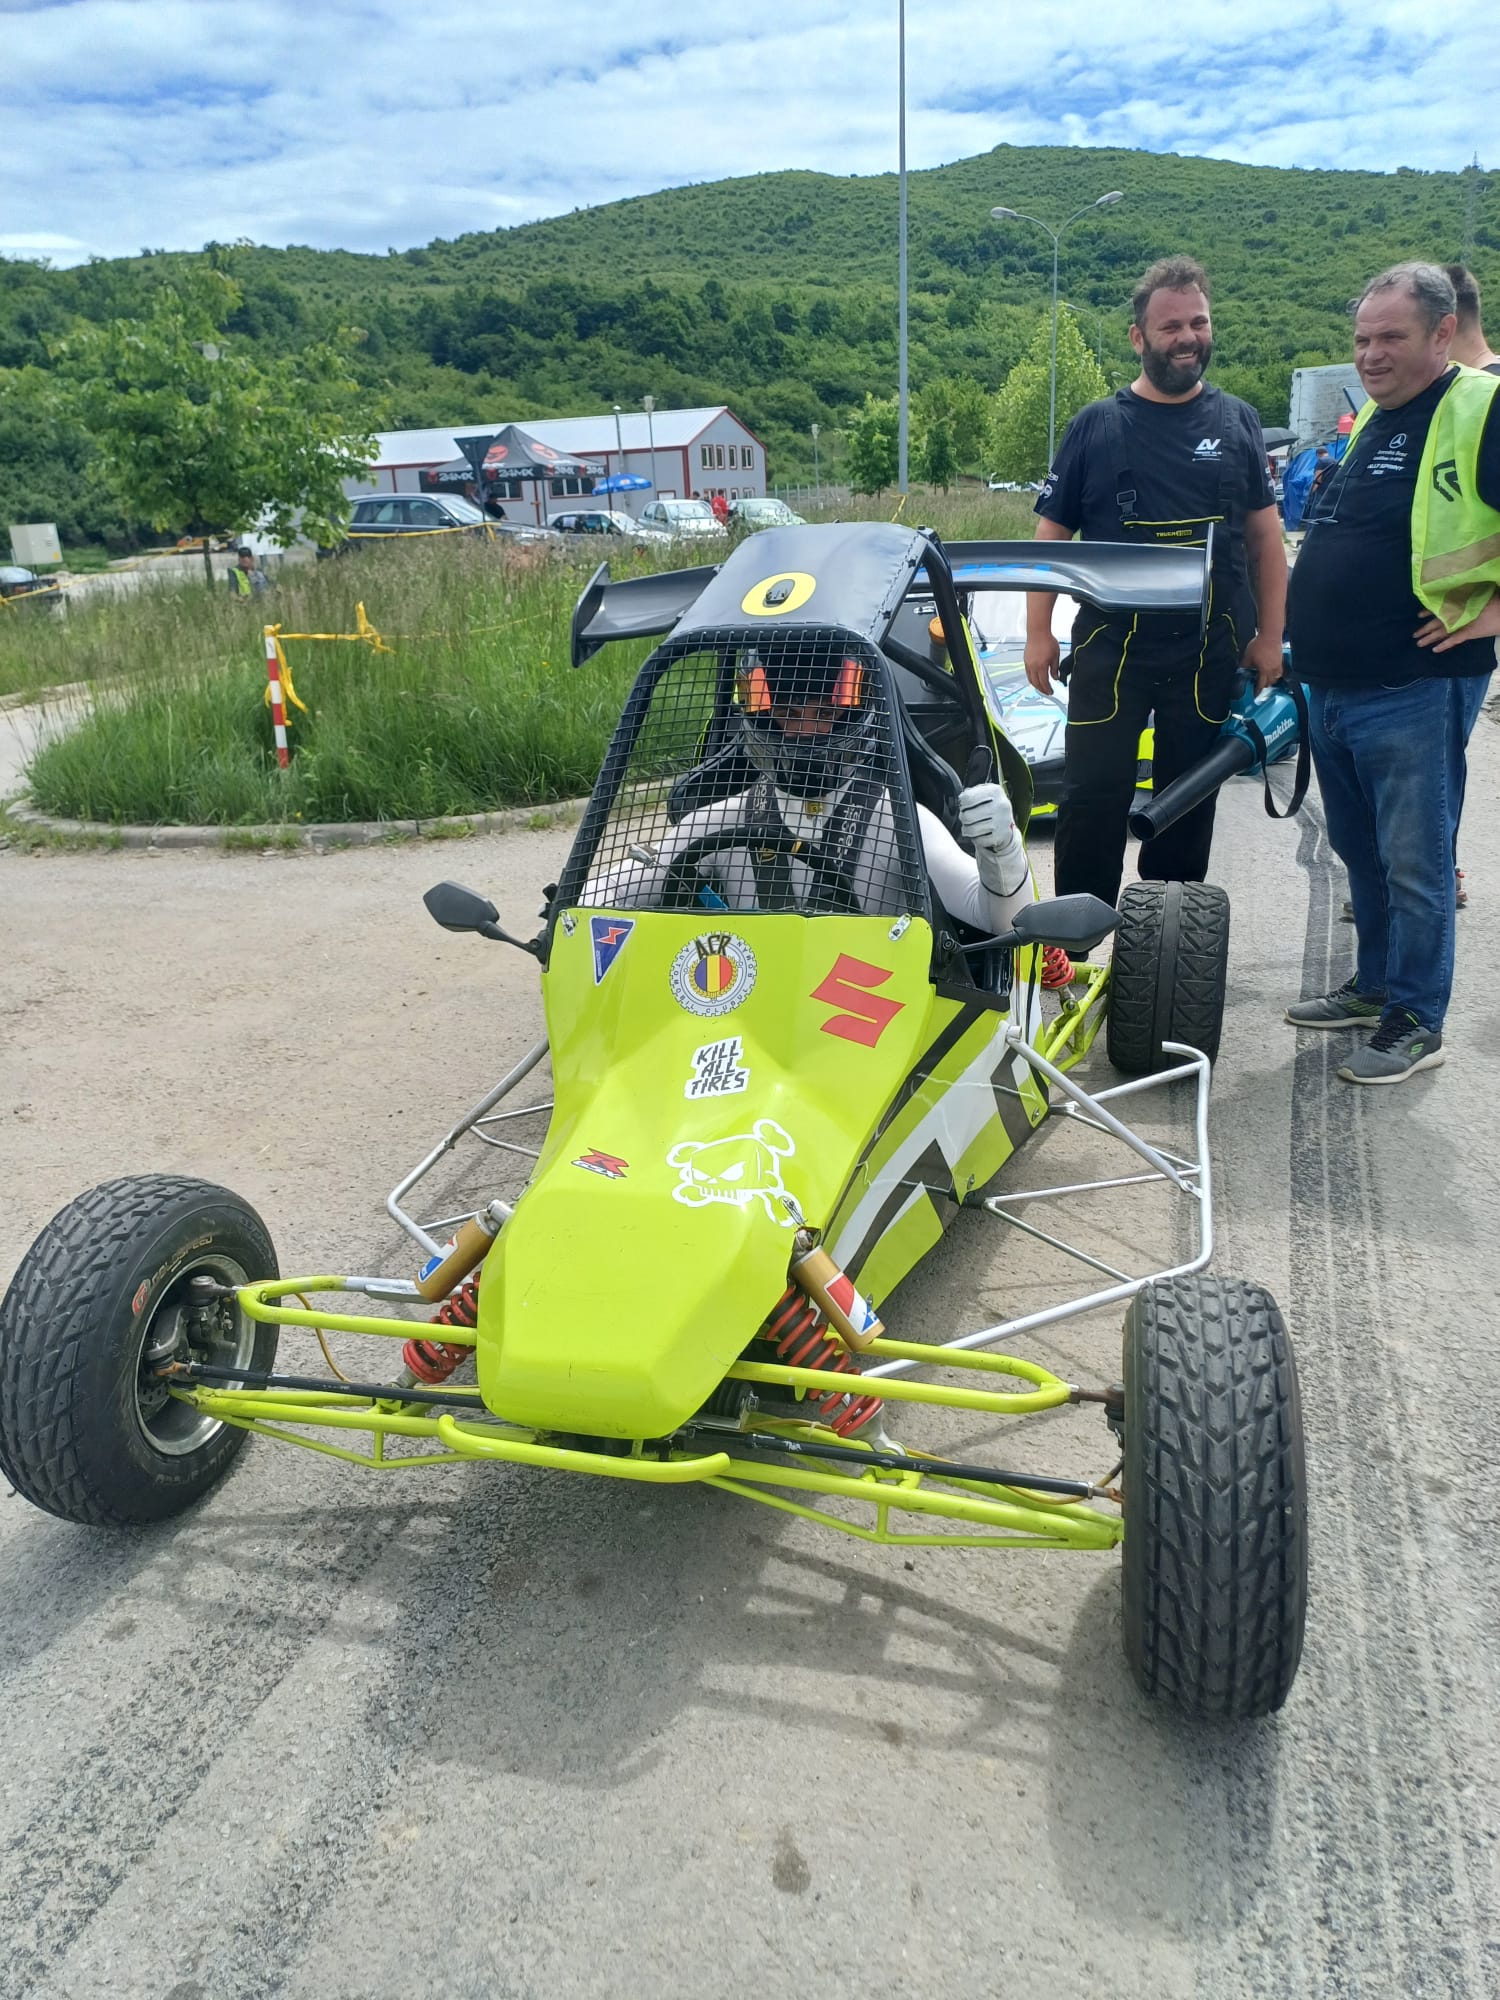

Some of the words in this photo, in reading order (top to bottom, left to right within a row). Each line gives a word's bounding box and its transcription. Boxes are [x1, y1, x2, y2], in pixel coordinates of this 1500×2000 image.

[439, 471, 474, 482] 24MX
[498, 467, 534, 479] 24MX
[696, 1039, 739, 1065] KILL
[701, 1056, 735, 1078] ALL
[691, 1071, 746, 1095] TIRES
